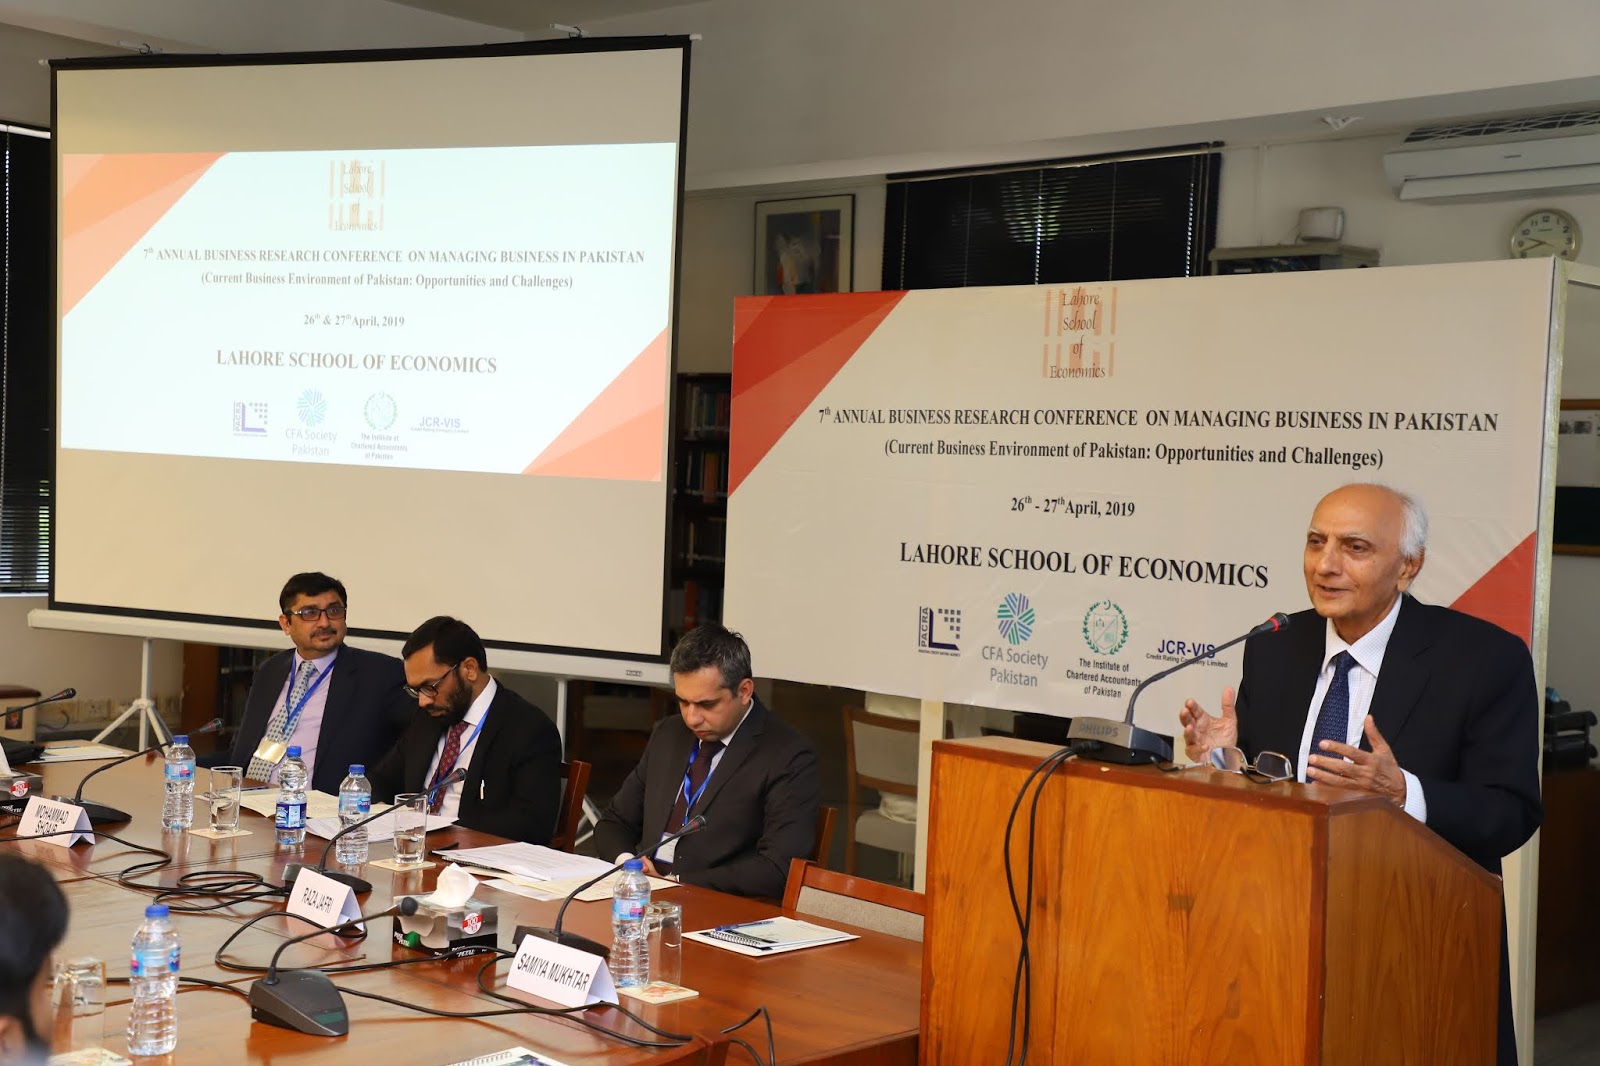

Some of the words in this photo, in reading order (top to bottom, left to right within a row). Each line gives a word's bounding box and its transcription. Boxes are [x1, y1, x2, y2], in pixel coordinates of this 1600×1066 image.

[143, 247, 153, 259] 7th
[156, 249, 201, 261] ANNUAL
[204, 249, 256, 262] BUSINESS
[259, 250, 320, 262] RESEARCH
[323, 250, 402, 263] CONFERENCE
[408, 251, 425, 263] ON
[429, 250, 497, 263] MANAGING
[500, 250, 559, 263] BUSINESS
[562, 250, 576, 263] IN
[579, 251, 645, 263] PAKISTAN
[201, 272, 242, 286] (Current
[246, 272, 285, 284] Business
[288, 273, 351, 285] Environment
[354, 273, 365, 285] of
[367, 274, 412, 286] Pakistan:
[415, 274, 486, 289] Opportunities
[489, 275, 508, 287] and
[512, 275, 573, 290] Challenges)
[1062, 286, 1100, 308] Lahore
[323, 315, 331, 325] &
[382, 316, 405, 327] 2019
[1063, 310, 1097, 332] School
[1072, 335, 1084, 358] of
[217, 350, 284, 366] LAHORE
[289, 352, 358, 369] SCHOOL
[363, 353, 386, 370] OF
[390, 354, 497, 374] ECONOMICS
[1050, 363, 1106, 378] Economics
[419, 416, 461, 429] JCR-VIS
[819, 406, 831, 424] 7th
[833, 409, 885, 424] ANNUAL
[889, 409, 950, 425] BUSINESS
[954, 409, 1029, 425] RESEARCH
[1034, 409, 1138, 426] CONFERENCE
[1146, 409, 1170, 427] ON
[1174, 410, 1270, 428] MANAGING
[1275, 411, 1362, 429] BUSINESS
[1368, 411, 1389, 430] IN
[1394, 412, 1498, 432] PAKISTAN
[285, 428, 302, 439] CFA
[305, 429, 338, 442] Society
[292, 443, 330, 456] Pakistan
[885, 439, 933, 457] (Current
[937, 440, 986, 456] Business
[989, 441, 1068, 457] Environment
[1073, 442, 1087, 457] of
[1089, 442, 1150, 460] Pakistan:
[1155, 443, 1254, 465] Opportunities
[1259, 445, 1287, 463] and
[1291, 446, 1384, 470] Challenges)
[1011, 495, 1032, 512] 26th
[1105, 500, 1135, 517] 2019
[900, 542, 982, 567] LAHORE
[988, 548, 1076, 573] SCHOOL
[1083, 553, 1113, 576] OF
[1119, 556, 1268, 589] ECONOMICS
[921, 607, 929, 648] PACRA
[982, 646, 1003, 661] CFA
[1007, 648, 1048, 670] Society
[1158, 639, 1215, 659] JCR-VIS
[1079, 657, 1091, 668] The
[1093, 659, 1121, 671] Institute
[1123, 663, 1129, 672] of
[1163, 654, 1179, 663] Rating
[1207, 660, 1228, 668] Limited
[990, 667, 1038, 687] Pakistan
[1066, 669, 1098, 682] Chartered
[1100, 673, 1141, 686] Accountants
[1084, 685, 1091, 694] of
[1092, 686, 1121, 698] Pakistan
[1080, 723, 1119, 737] PHILIPS
[35, 804, 69, 824] MOHAMMAD
[301, 887, 319, 907] RAZA
[316, 894, 335, 914] JAFRI
[517, 953, 549, 978] SAMIYA
[548, 962, 590, 991] MUKHTAR
